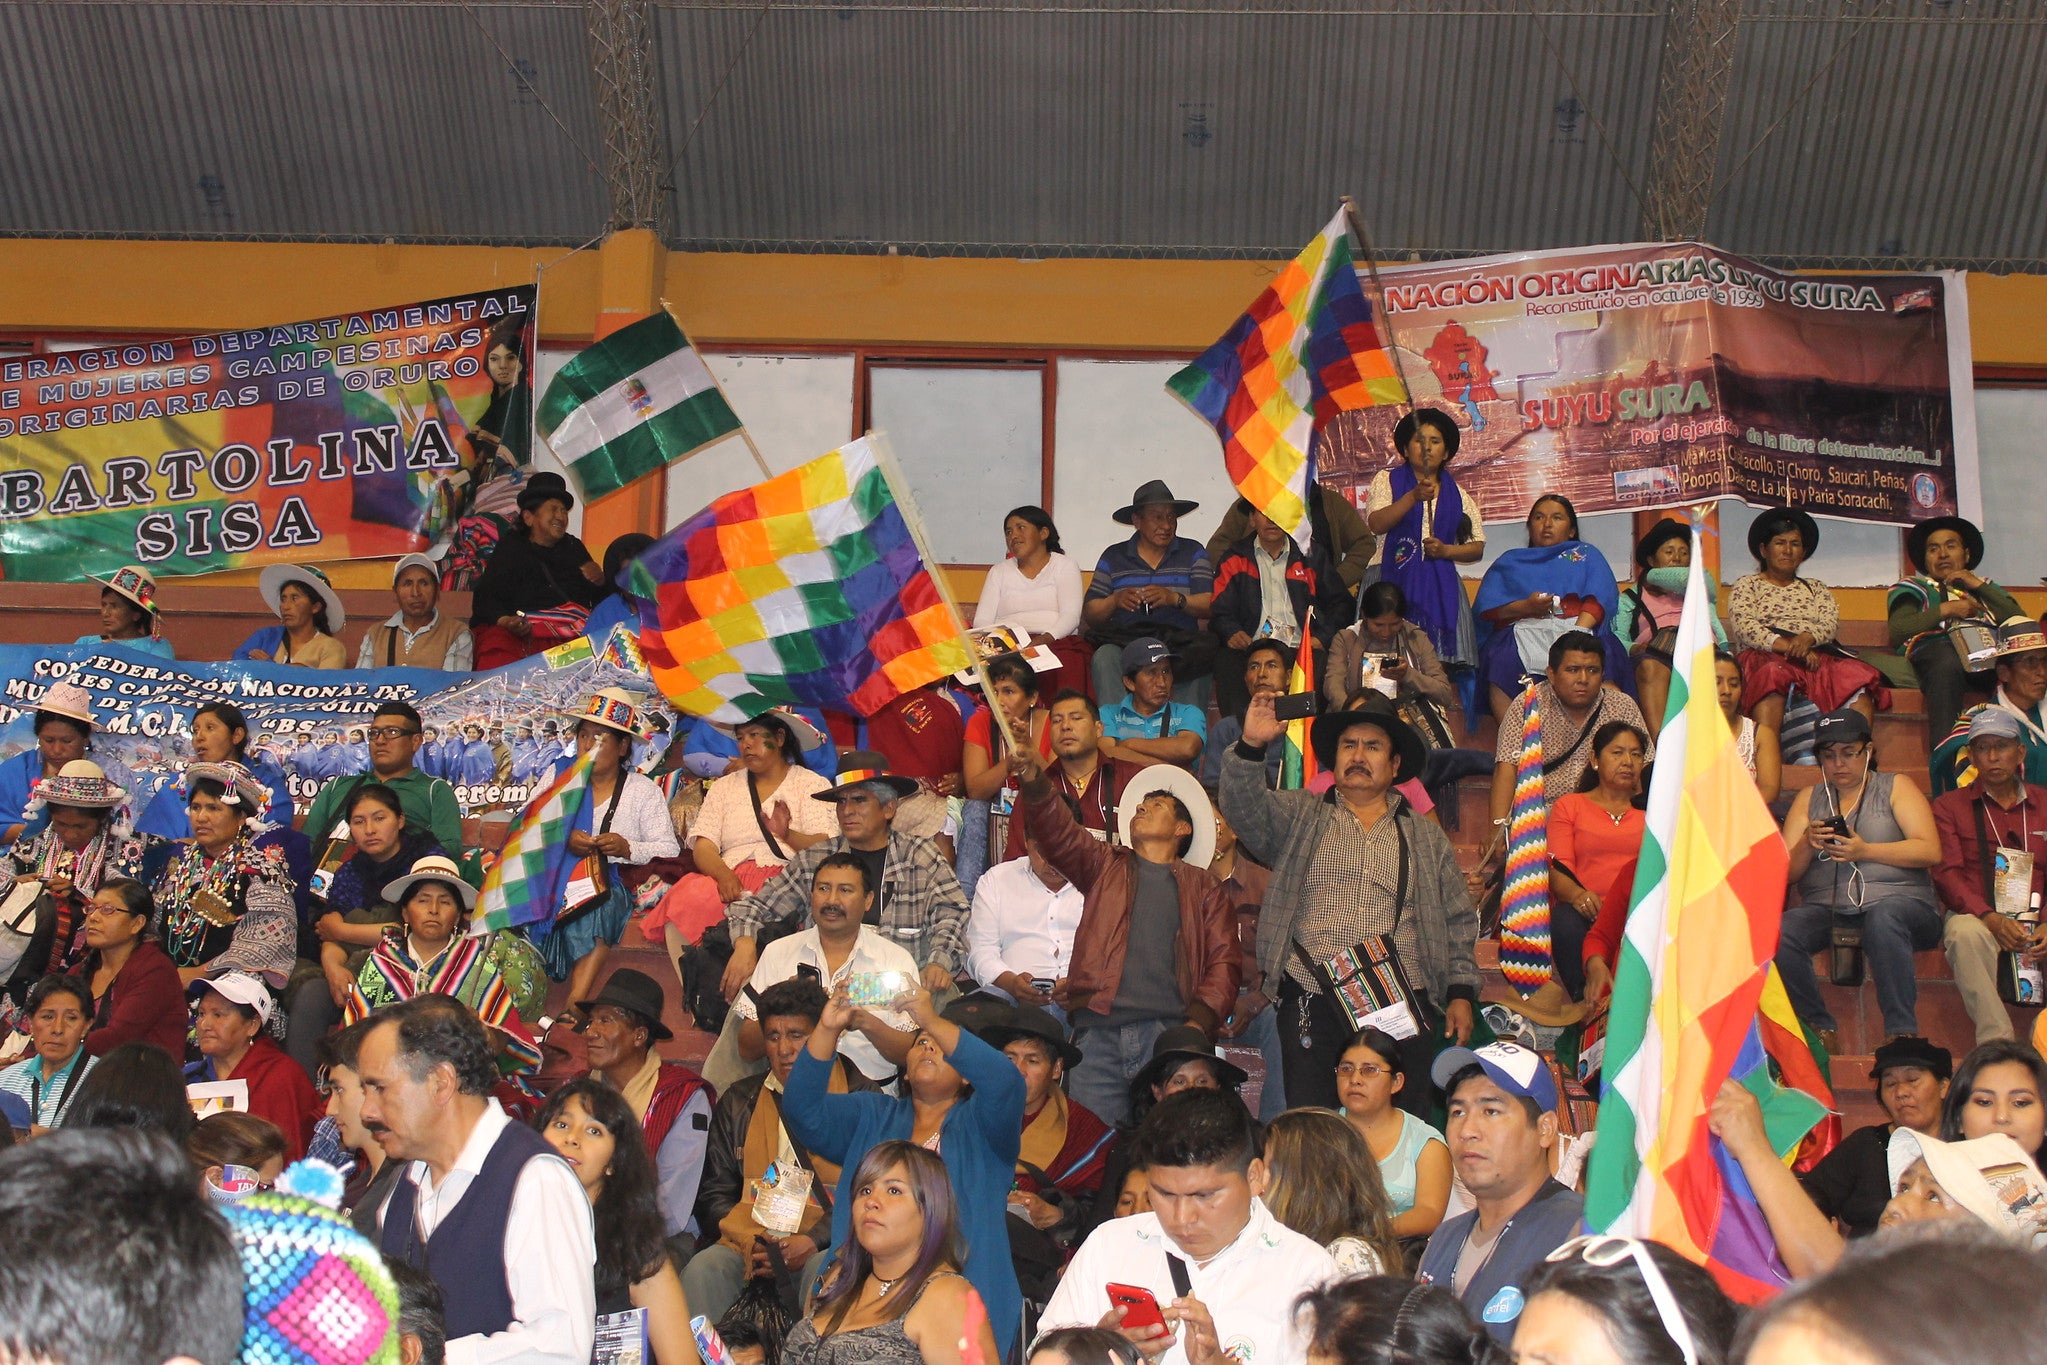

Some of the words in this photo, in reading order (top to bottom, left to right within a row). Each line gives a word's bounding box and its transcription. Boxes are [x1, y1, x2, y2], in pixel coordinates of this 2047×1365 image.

[1386, 274, 1514, 314] NACIÓN
[1789, 280, 1885, 311] SURA
[1628, 292, 1648, 305] en
[1651, 286, 1709, 304] octubre
[1711, 286, 1726, 303] de
[1730, 287, 1764, 308] 1999
[193, 295, 527, 357] DEPARTAMENTAL
[39, 365, 212, 405] MUJERES
[228, 328, 482, 379] CAMPESINAS
[0, 385, 260, 438] ORIGINARIAS
[278, 377, 327, 401] DE
[343, 356, 480, 393] ORURO
[1523, 391, 1612, 430] SUYU
[1619, 380, 1712, 420] SURA
[1631, 427, 1660, 446] Por
[1663, 422, 1678, 442] el
[1746, 426, 1763, 445] de
[1763, 430, 1778, 449] la
[1779, 433, 1815, 453] libre
[0, 418, 459, 519] BARTOLINA
[1787, 462, 1824, 485] Choro,
[1808, 486, 1836, 505] Paria
[136, 496, 321, 562] SISA
[97, 696, 134, 712] DE
[240, 679, 369, 699] NACIONAL
